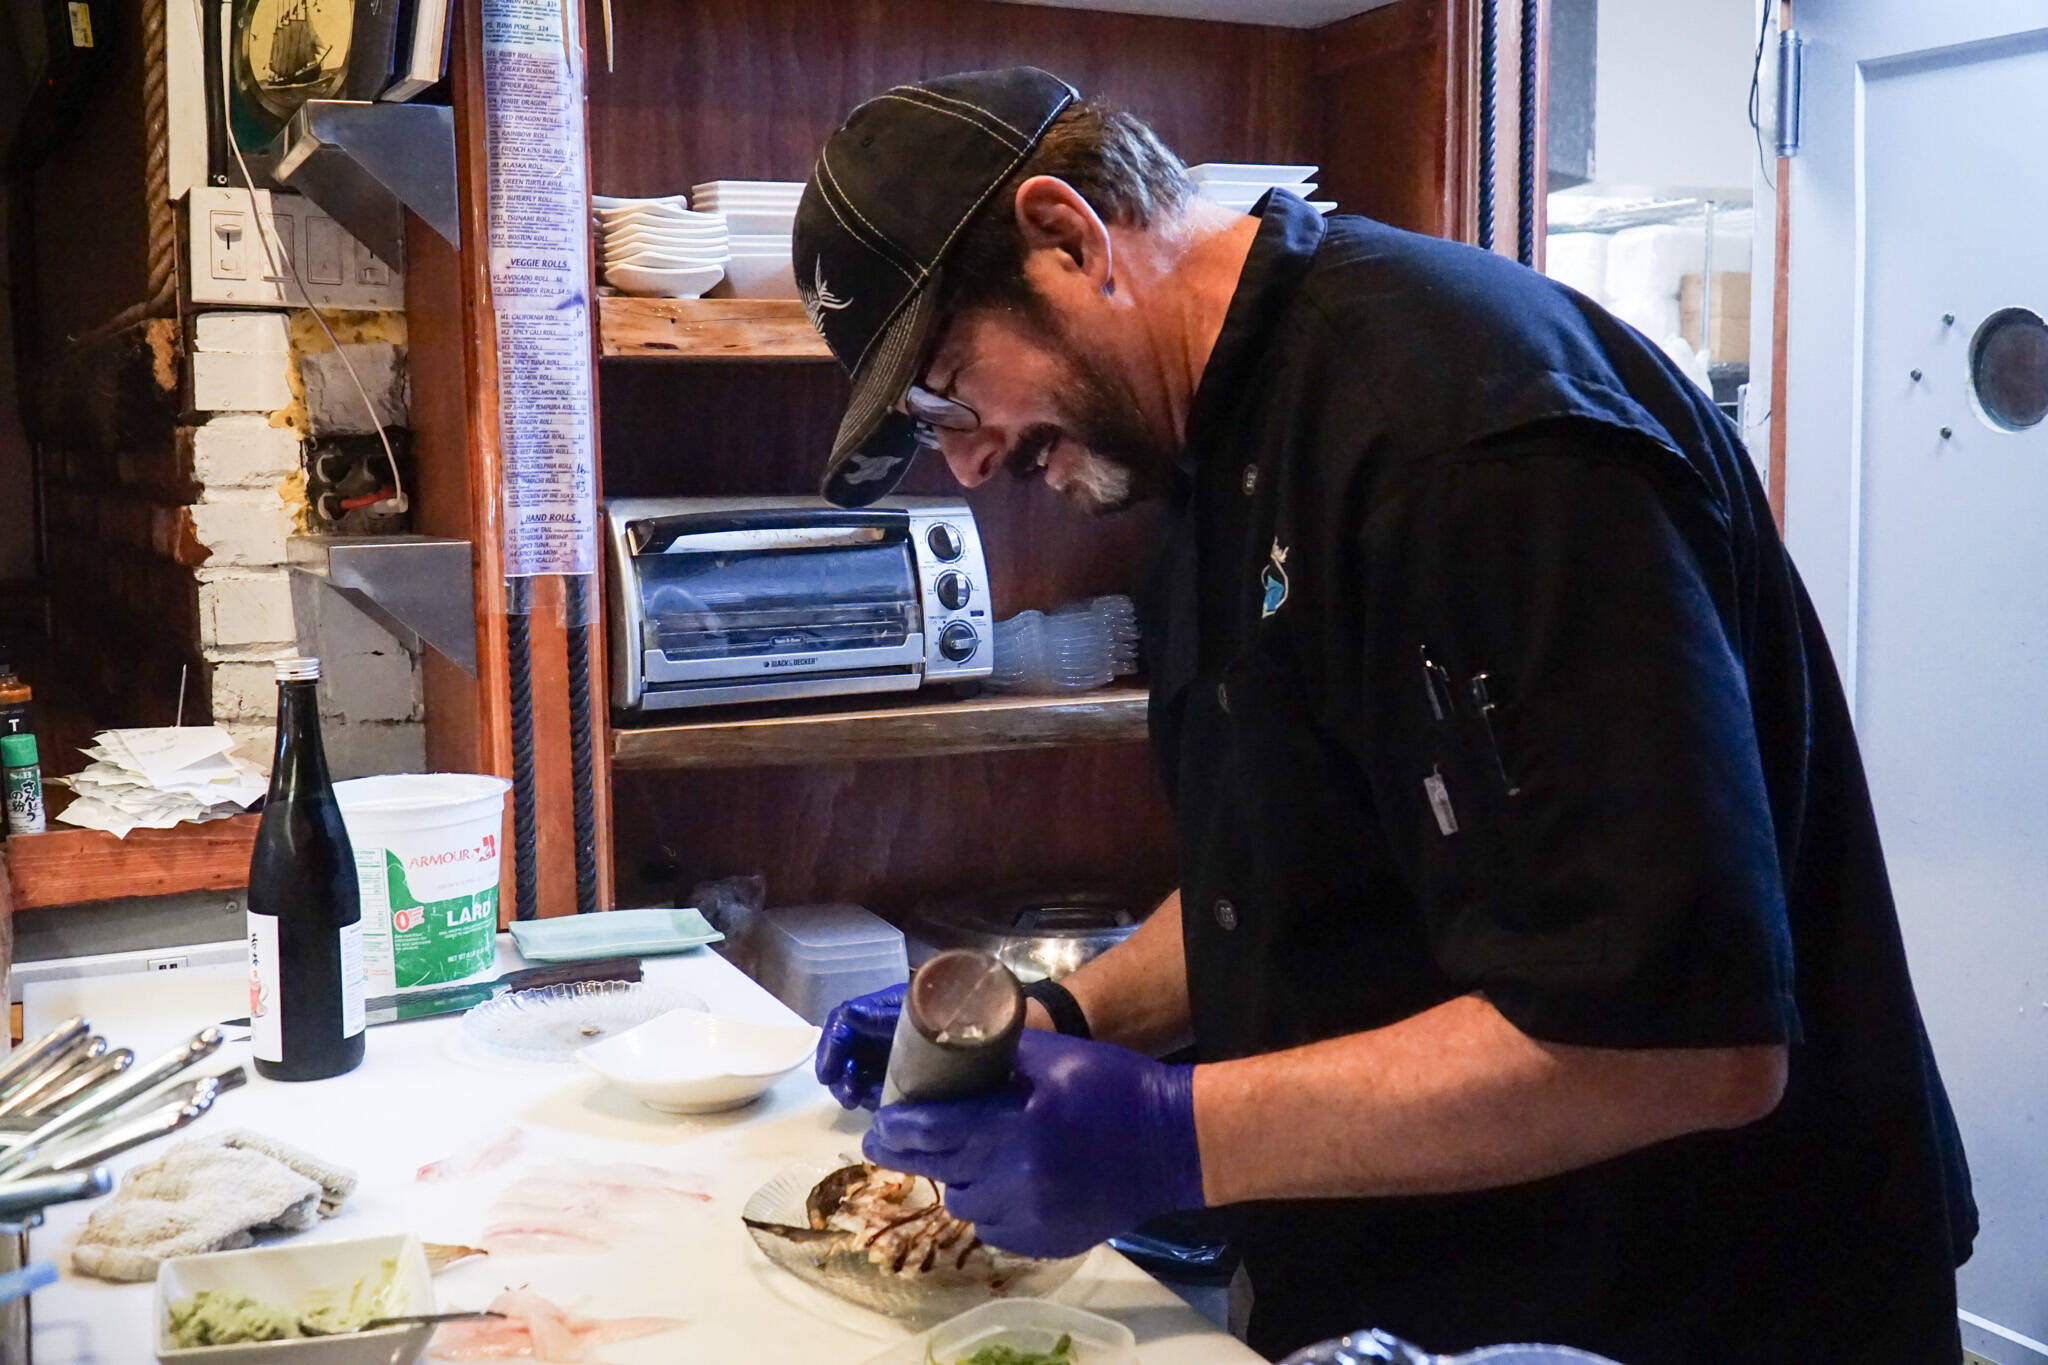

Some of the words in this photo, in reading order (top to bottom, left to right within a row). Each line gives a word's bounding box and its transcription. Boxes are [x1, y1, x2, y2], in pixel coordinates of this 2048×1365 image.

[510, 258, 539, 267] VEGGIE
[541, 259, 567, 268] ROLLS
[525, 513, 547, 522] HAND
[549, 513, 576, 521] ROLLS
[8, 719, 20, 732] T
[409, 848, 472, 869] ARMOUR
[447, 899, 491, 927] LARD
